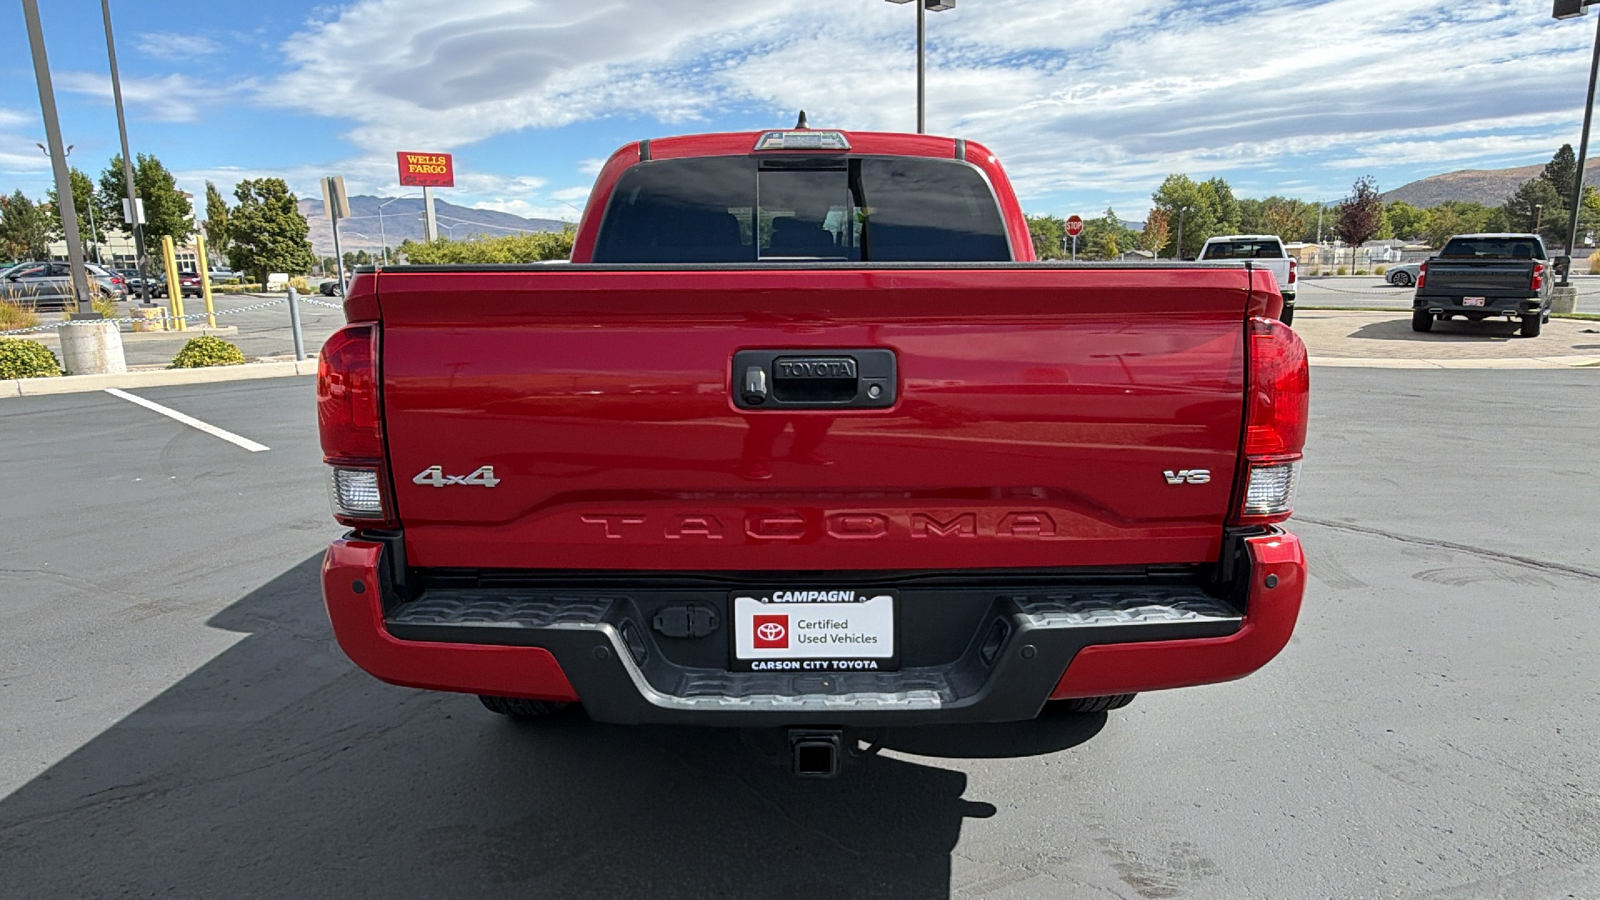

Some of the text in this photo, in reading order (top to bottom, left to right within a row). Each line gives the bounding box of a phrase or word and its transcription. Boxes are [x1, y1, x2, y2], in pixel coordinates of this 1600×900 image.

[406, 155, 446, 165] WELLS
[408, 164, 446, 174] FARGO
[1066, 221, 1082, 230] STOP
[780, 362, 852, 377] TOYOTA
[412, 465, 501, 487] 4x4
[1163, 469, 1211, 484] V6
[580, 511, 1057, 539] TACOMA
[772, 590, 855, 603] CAMPAGNI
[797, 619, 849, 630] Certified
[798, 633, 878, 644] Used Vehicles
[751, 660, 878, 670] CARSON CITY TOYOTA
